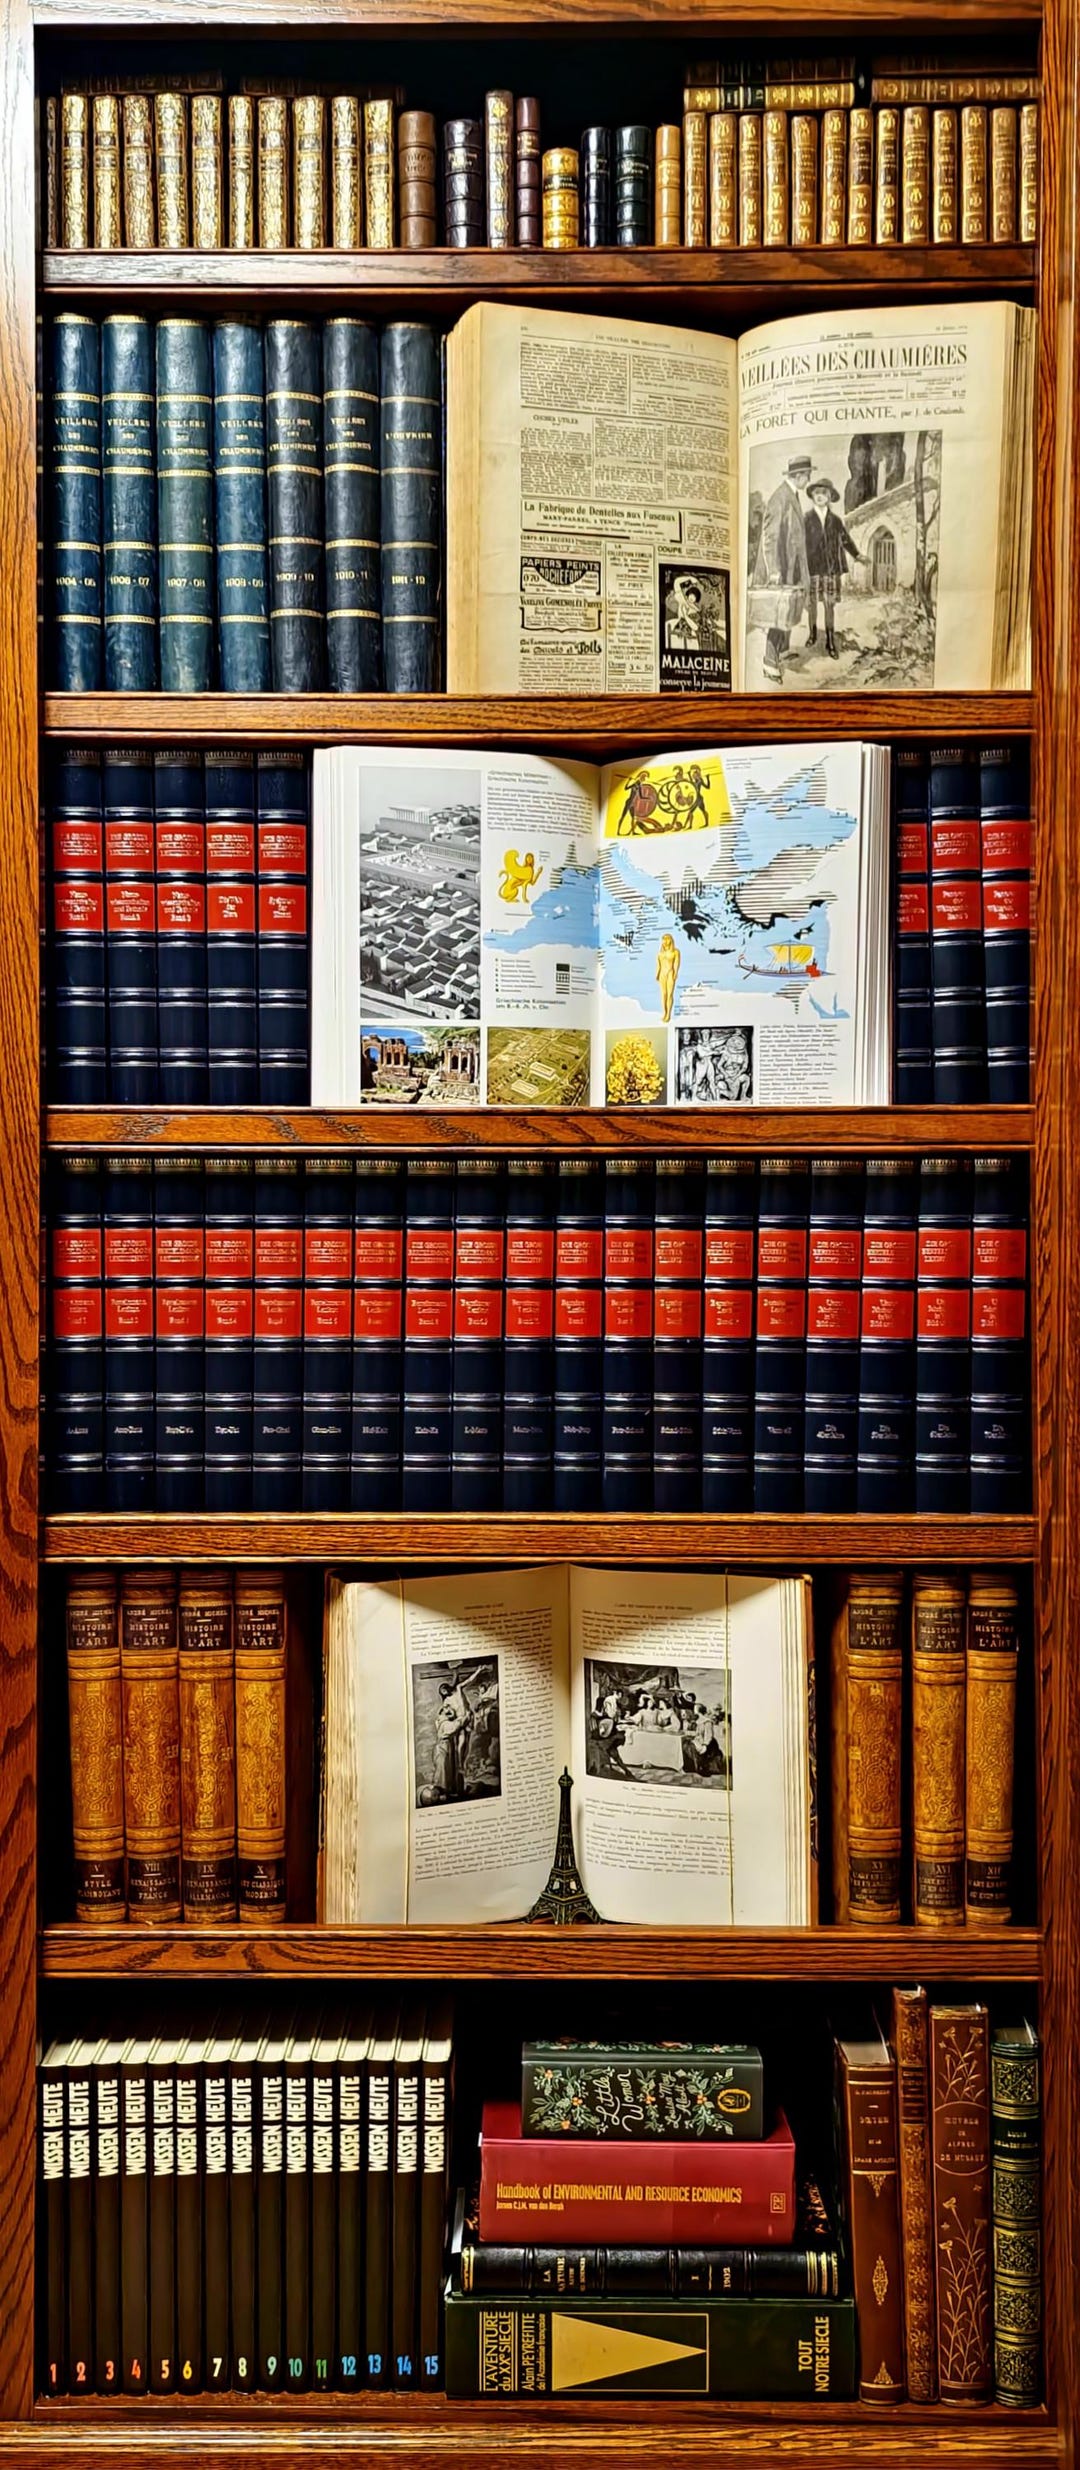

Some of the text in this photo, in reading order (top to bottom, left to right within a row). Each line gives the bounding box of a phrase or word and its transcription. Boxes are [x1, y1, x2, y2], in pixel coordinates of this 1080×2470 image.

[816, 351, 848, 372] DES
[756, 412, 797, 432] FORÊT
[804, 409, 828, 424] QUI
[524, 501, 535, 512] La
[538, 502, 575, 516] Fabrique
[576, 504, 586, 514] de
[589, 504, 624, 518] Dentelles
[522, 558, 600, 571] PAPIERS PEINTS
[593, 2074, 620, 2126] Little
[617, 2068, 644, 2132] Women
[43, 2083, 64, 2179] WISSEN HEUTE
[69, 2081, 90, 2178] WISSEN HEUTE
[98, 2079, 118, 2177] WISSEN HEUTE
[125, 2078, 146, 2175] WISSEN HEUTE
[153, 2079, 174, 2176] WISSEN HEUTE
[177, 2079, 197, 2175] WISSEN HEUTE
[205, 2078, 226, 2174] WISSEN HEUTE
[232, 2078, 252, 2174] WISSEN HEUTE
[262, 2076, 282, 2173] WISSEN HEUTE
[286, 2077, 306, 2173] WISSEN HEUTE
[313, 2077, 333, 2173] WISSEN HEUTE
[340, 2076, 360, 2172] WISSEN HEUTE
[368, 2076, 389, 2172] WISSEN HEUTE
[397, 2077, 418, 2173] WISSEN HEUTE
[423, 2077, 445, 2173] WISSEN HEUTE
[496, 2182, 742, 2204] Handbook of ENVIRONMENTAL AND RESOURCE ECONOMICS
[368, 2354, 382, 2374] 13
[396, 2355, 412, 2375] 14
[486, 2311, 498, 2391] L'AVENTURE
[522, 2312, 535, 2391] Alain PEYREFITTE
[798, 2339, 812, 2372] TOUT
[815, 2316, 829, 2392] NOTRE SIECLE
[50, 2363, 56, 2383] 1
[76, 2361, 86, 2381] 2
[106, 2360, 114, 2380] 3
[131, 2359, 141, 2379] 4
[161, 2359, 170, 2379] 5
[182, 2360, 192, 2380] 6
[212, 2357, 222, 2377] 7
[238, 2357, 247, 2377] 8
[267, 2356, 277, 2376] 9
[288, 2358, 303, 2377] 10
[315, 2359, 327, 2379] 11
[341, 2356, 356, 2376] 12
[424, 2355, 439, 2376] 15
[500, 2377, 511, 2391] du
